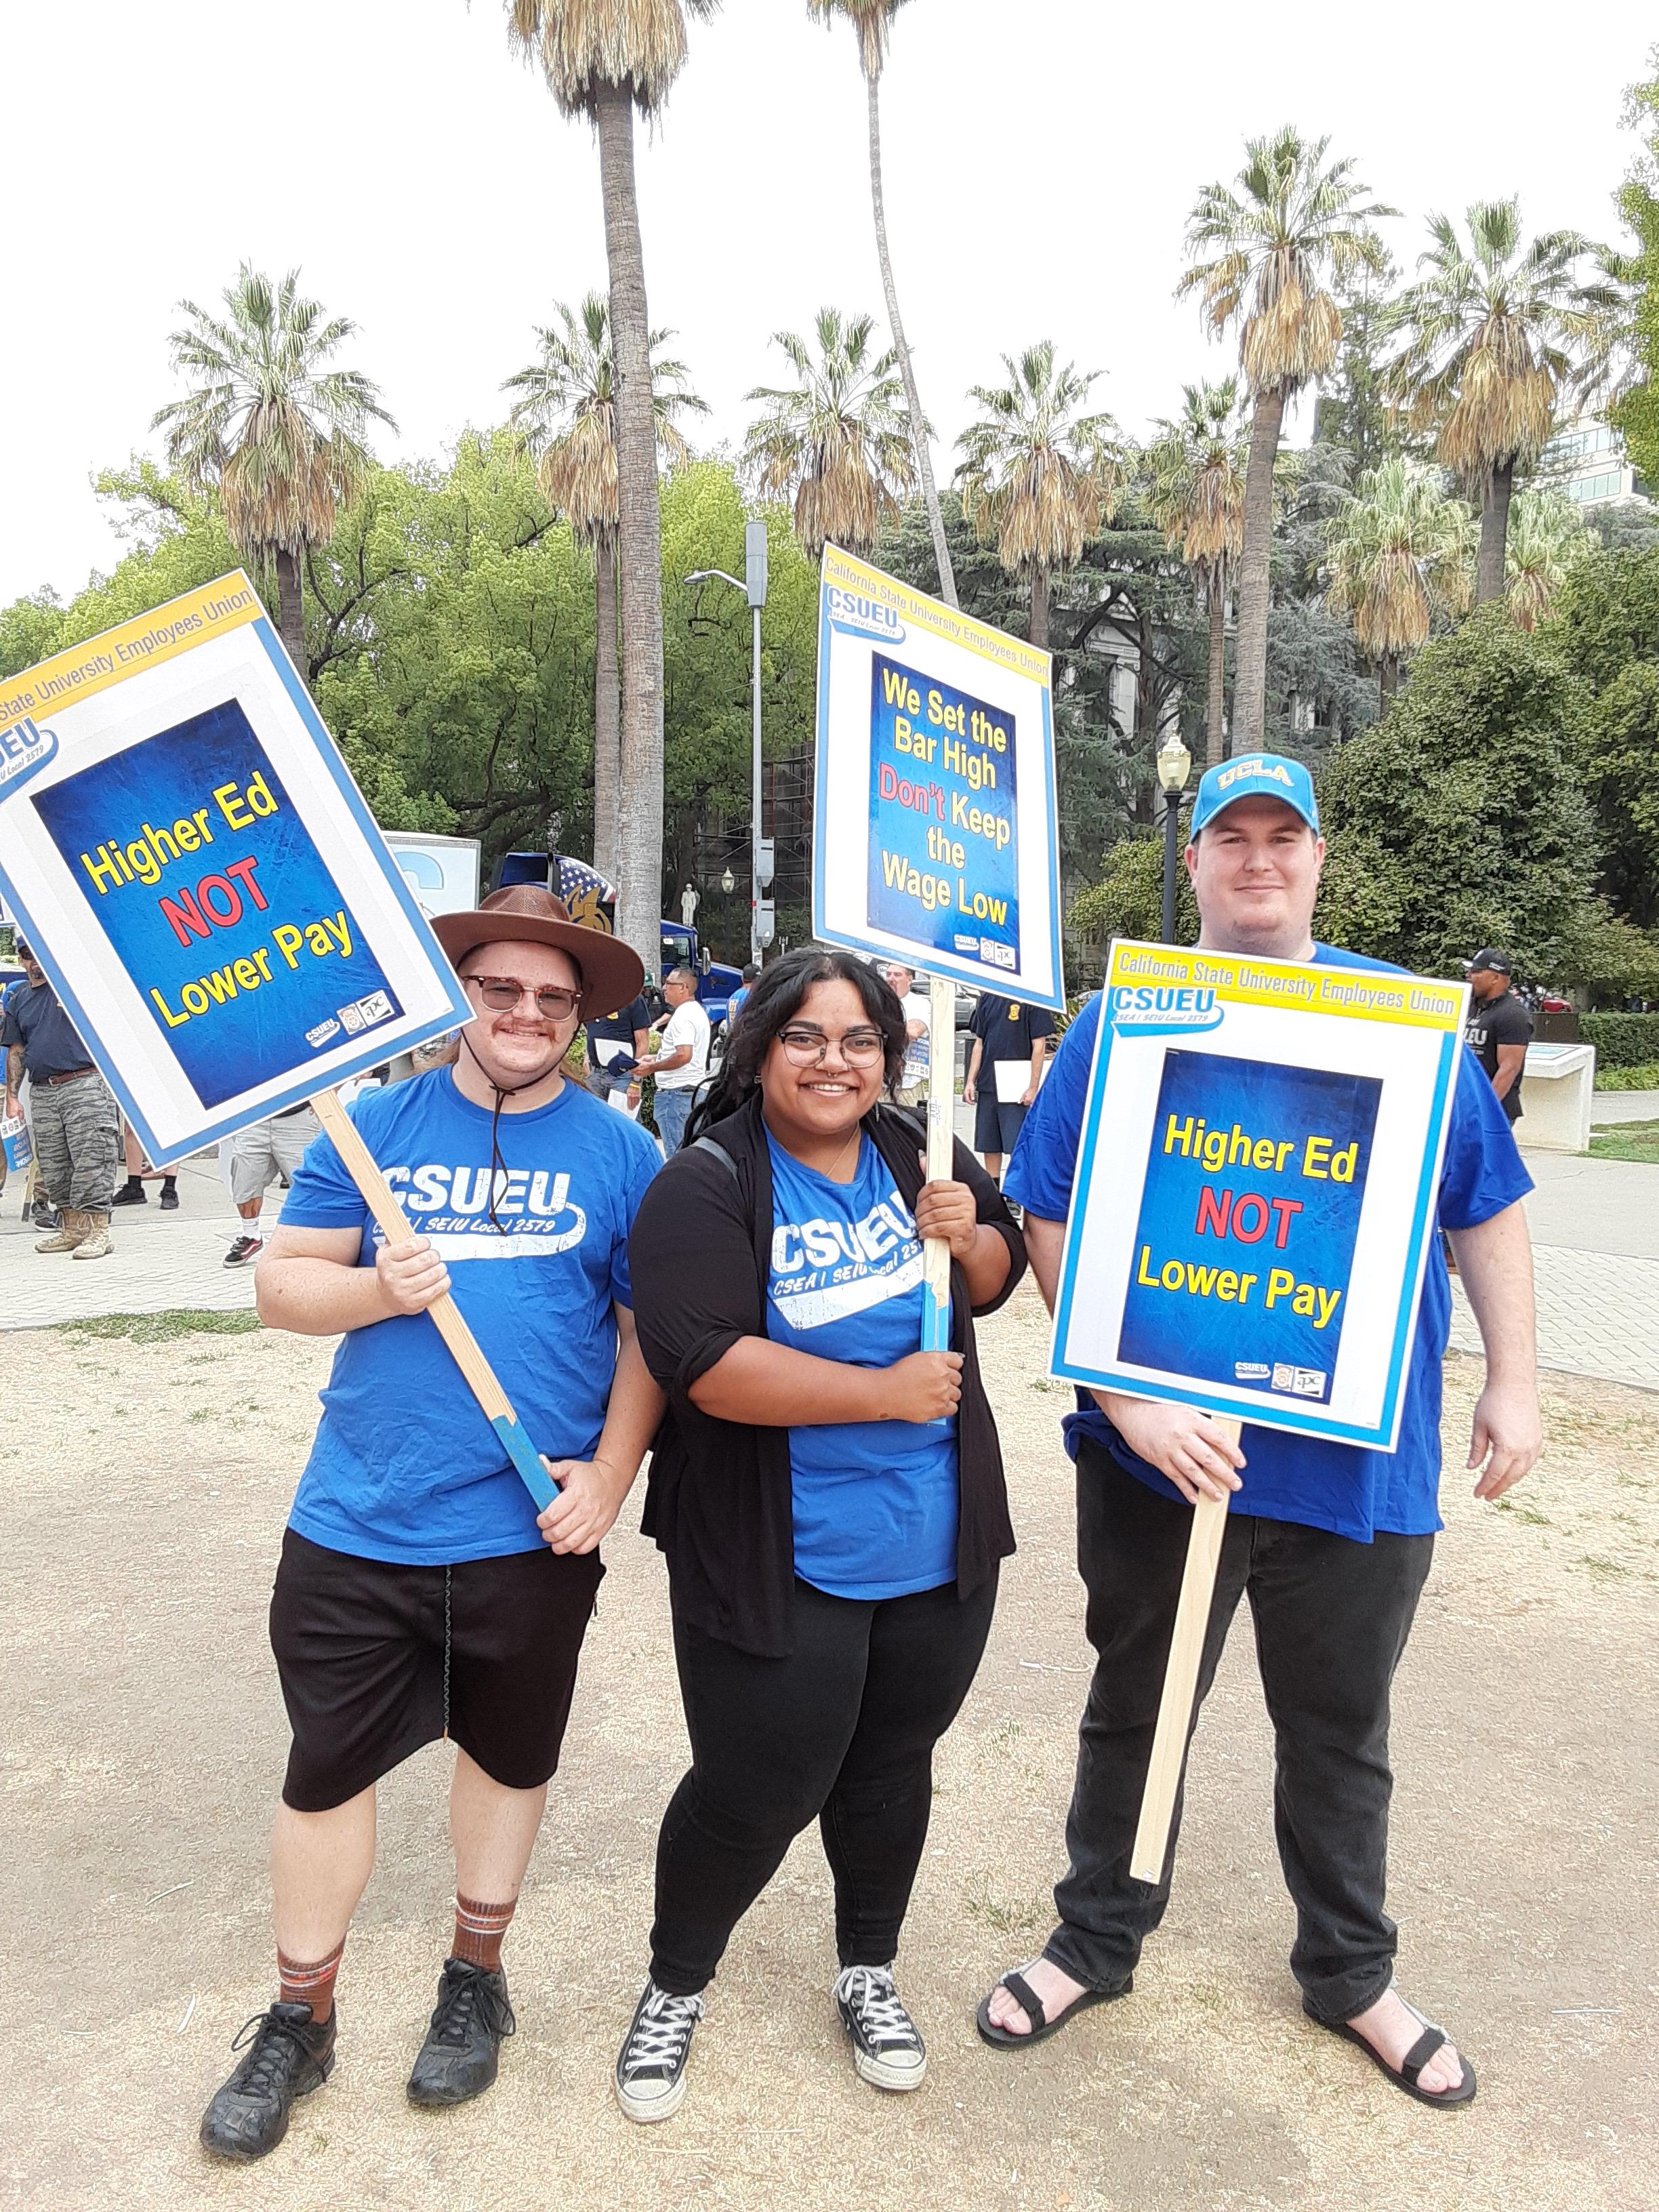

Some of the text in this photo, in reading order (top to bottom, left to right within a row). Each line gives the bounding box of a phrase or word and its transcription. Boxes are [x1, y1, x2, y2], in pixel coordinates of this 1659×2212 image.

[826, 557, 1048, 676] California State University Employees Union
[828, 587, 897, 628] CSUEU
[35, 654, 115, 700] University
[115, 613, 203, 662] Employees
[203, 589, 254, 621] Union
[883, 668, 1007, 753] We Set the
[895, 716, 997, 790] Bar High
[1218, 759, 1295, 790] UCLA
[80, 771, 279, 895] Higher Ed
[879, 762, 1010, 851] Don't Keep
[926, 825, 966, 869] the
[159, 855, 268, 948] NOT
[882, 849, 1008, 926] Wage Low
[150, 911, 352, 1029] Lower Pay
[1115, 987, 1215, 1013] CSUEU
[1120, 952, 1454, 1015] California State University Employees Union
[305, 1018, 335, 1042] CSUEU
[1143, 1014, 1164, 1022] SEIU
[1164, 1113, 1359, 1184] Higher Ed
[382, 1164, 571, 1216] CSUEU
[1195, 1186, 1304, 1250] NOT
[425, 1217, 467, 1231] SEIU
[470, 1218, 513, 1232] Local
[513, 1219, 556, 1233] 2579
[772, 1190, 917, 1274] CSUEU
[773, 1272, 818, 1296] CSEA
[832, 1263, 867, 1283] SEIU
[1136, 1245, 1342, 1330] Lower Pay
[1235, 1361, 1268, 1372] CSUEU
